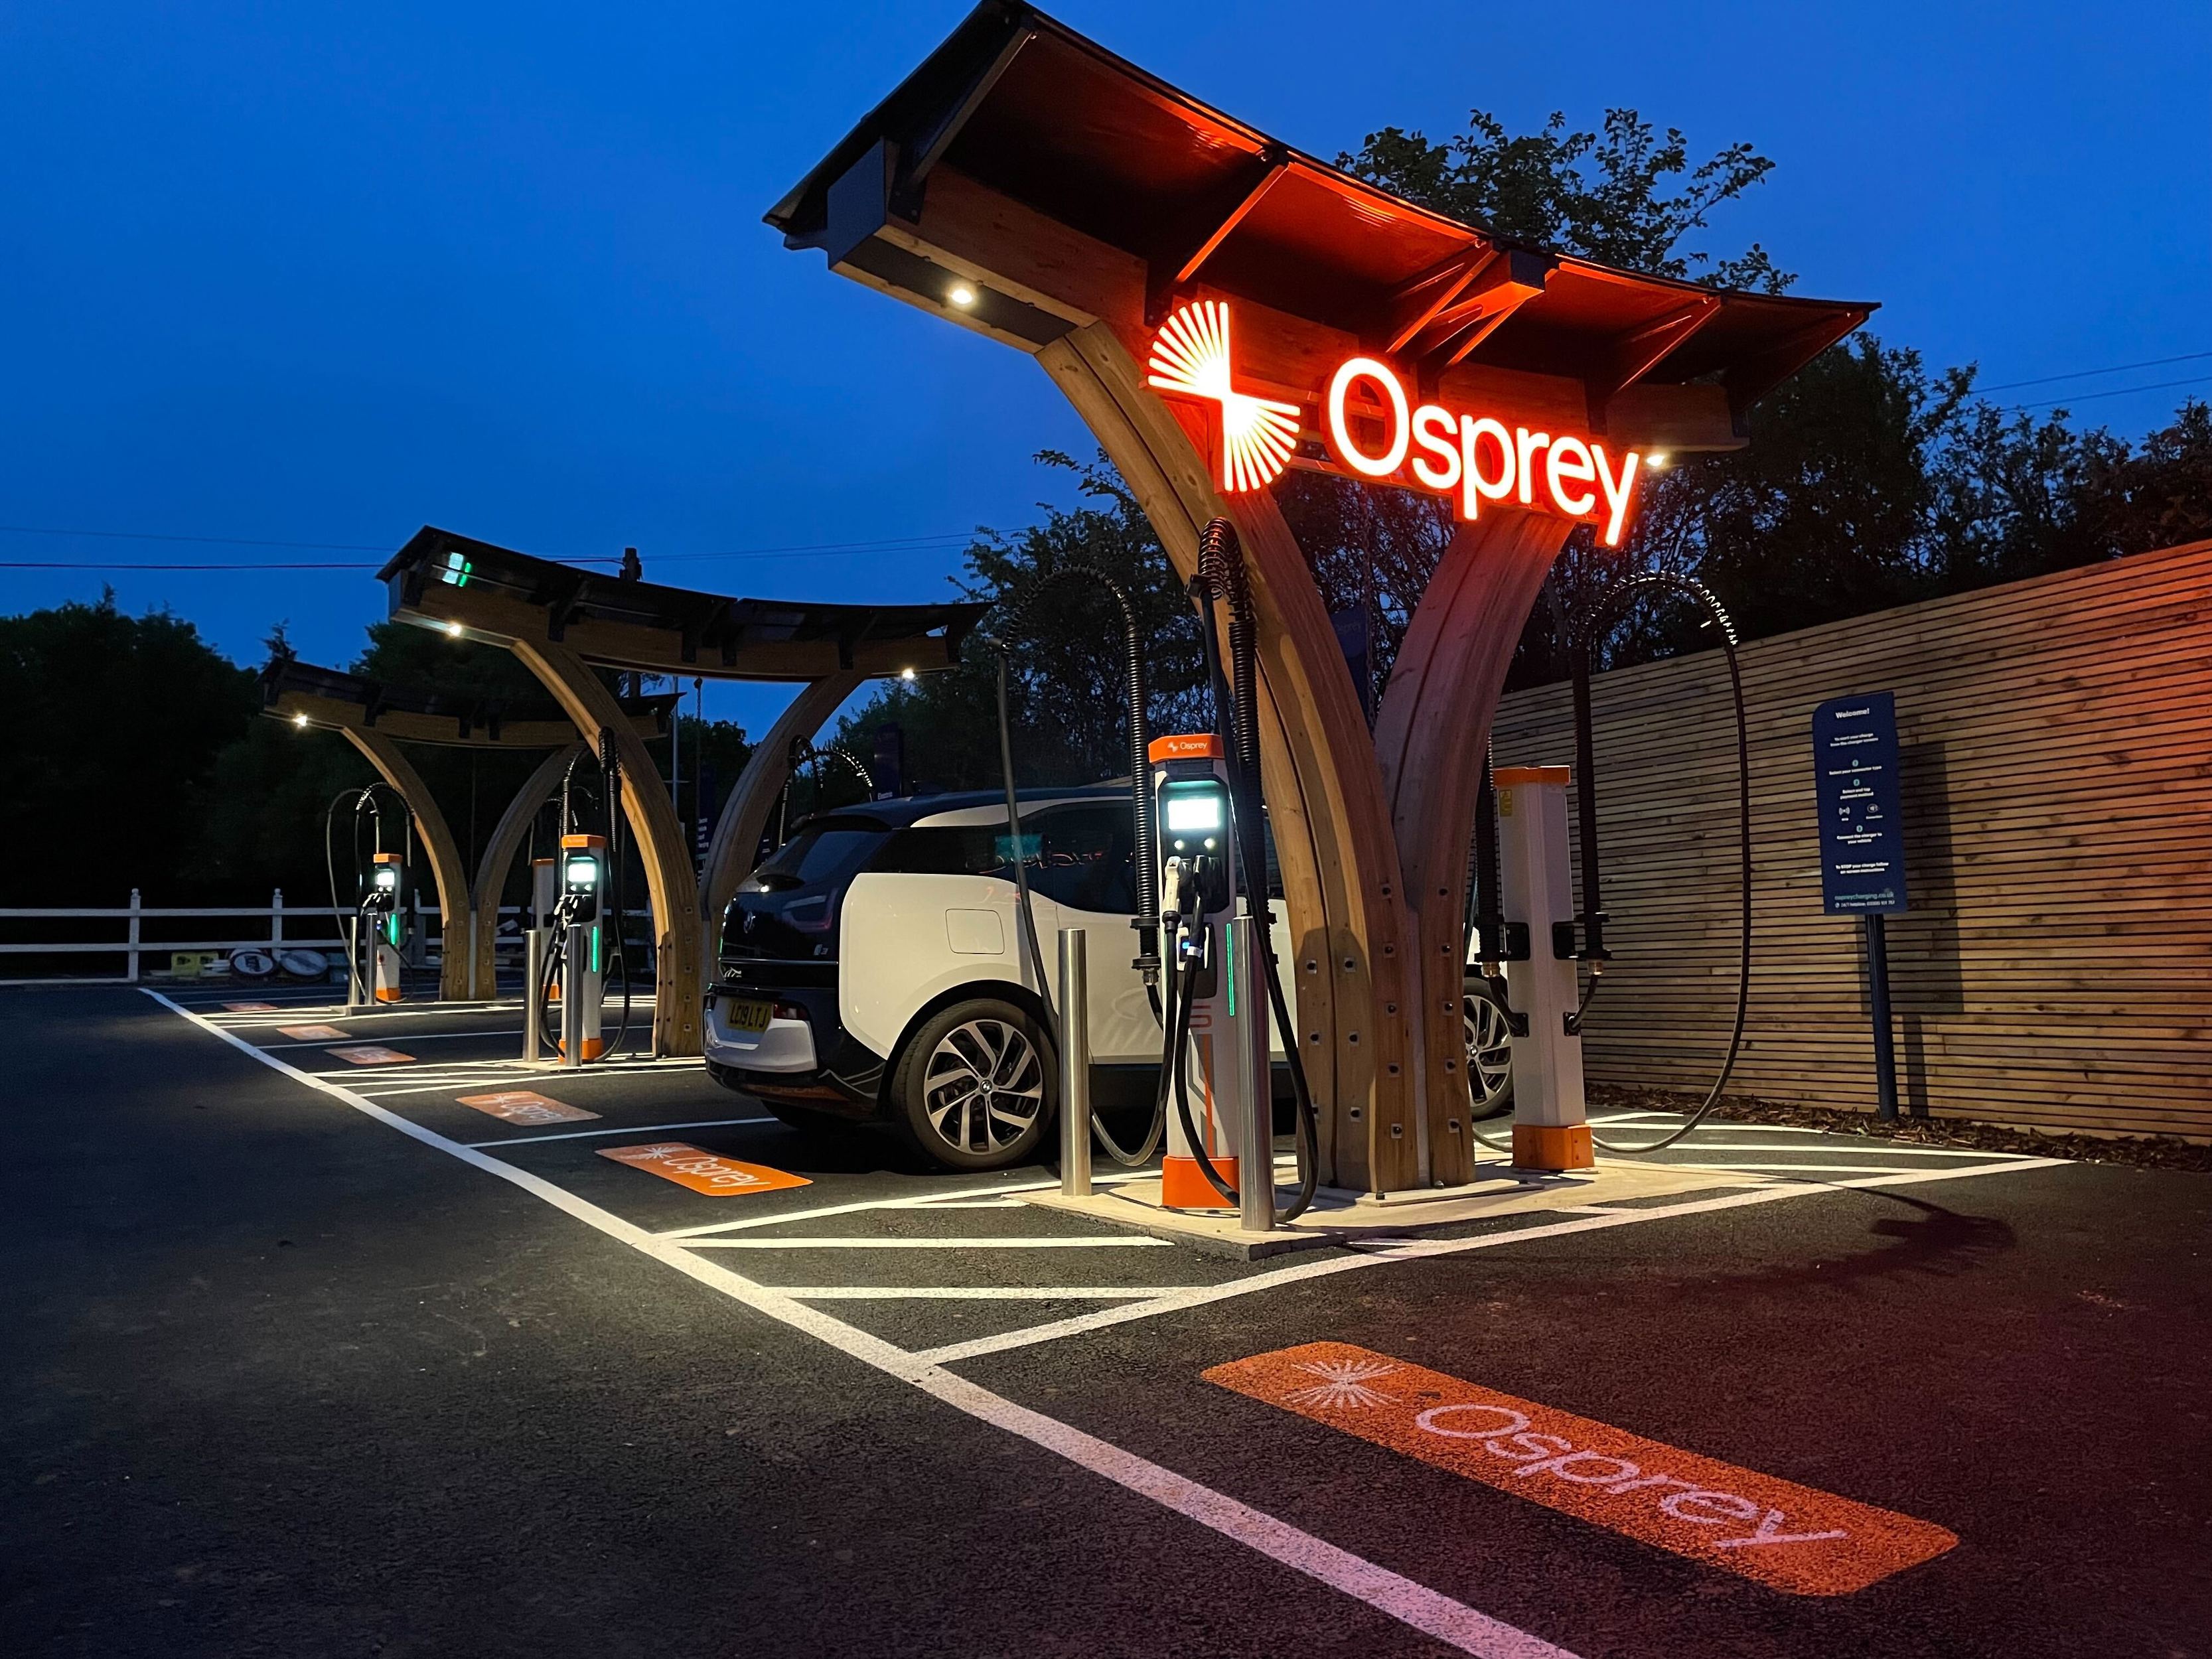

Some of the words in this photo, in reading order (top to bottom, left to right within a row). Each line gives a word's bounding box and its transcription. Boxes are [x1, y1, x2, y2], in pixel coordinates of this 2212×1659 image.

[1329, 357, 1639, 546] Osprey
[1835, 707, 1870, 719] Welcome!
[1180, 742, 1207, 751] Osprey
[748, 1005, 767, 1028] LTJ
[662, 1157, 771, 1188] Osprey
[1415, 1404, 1848, 1550] Osprey
